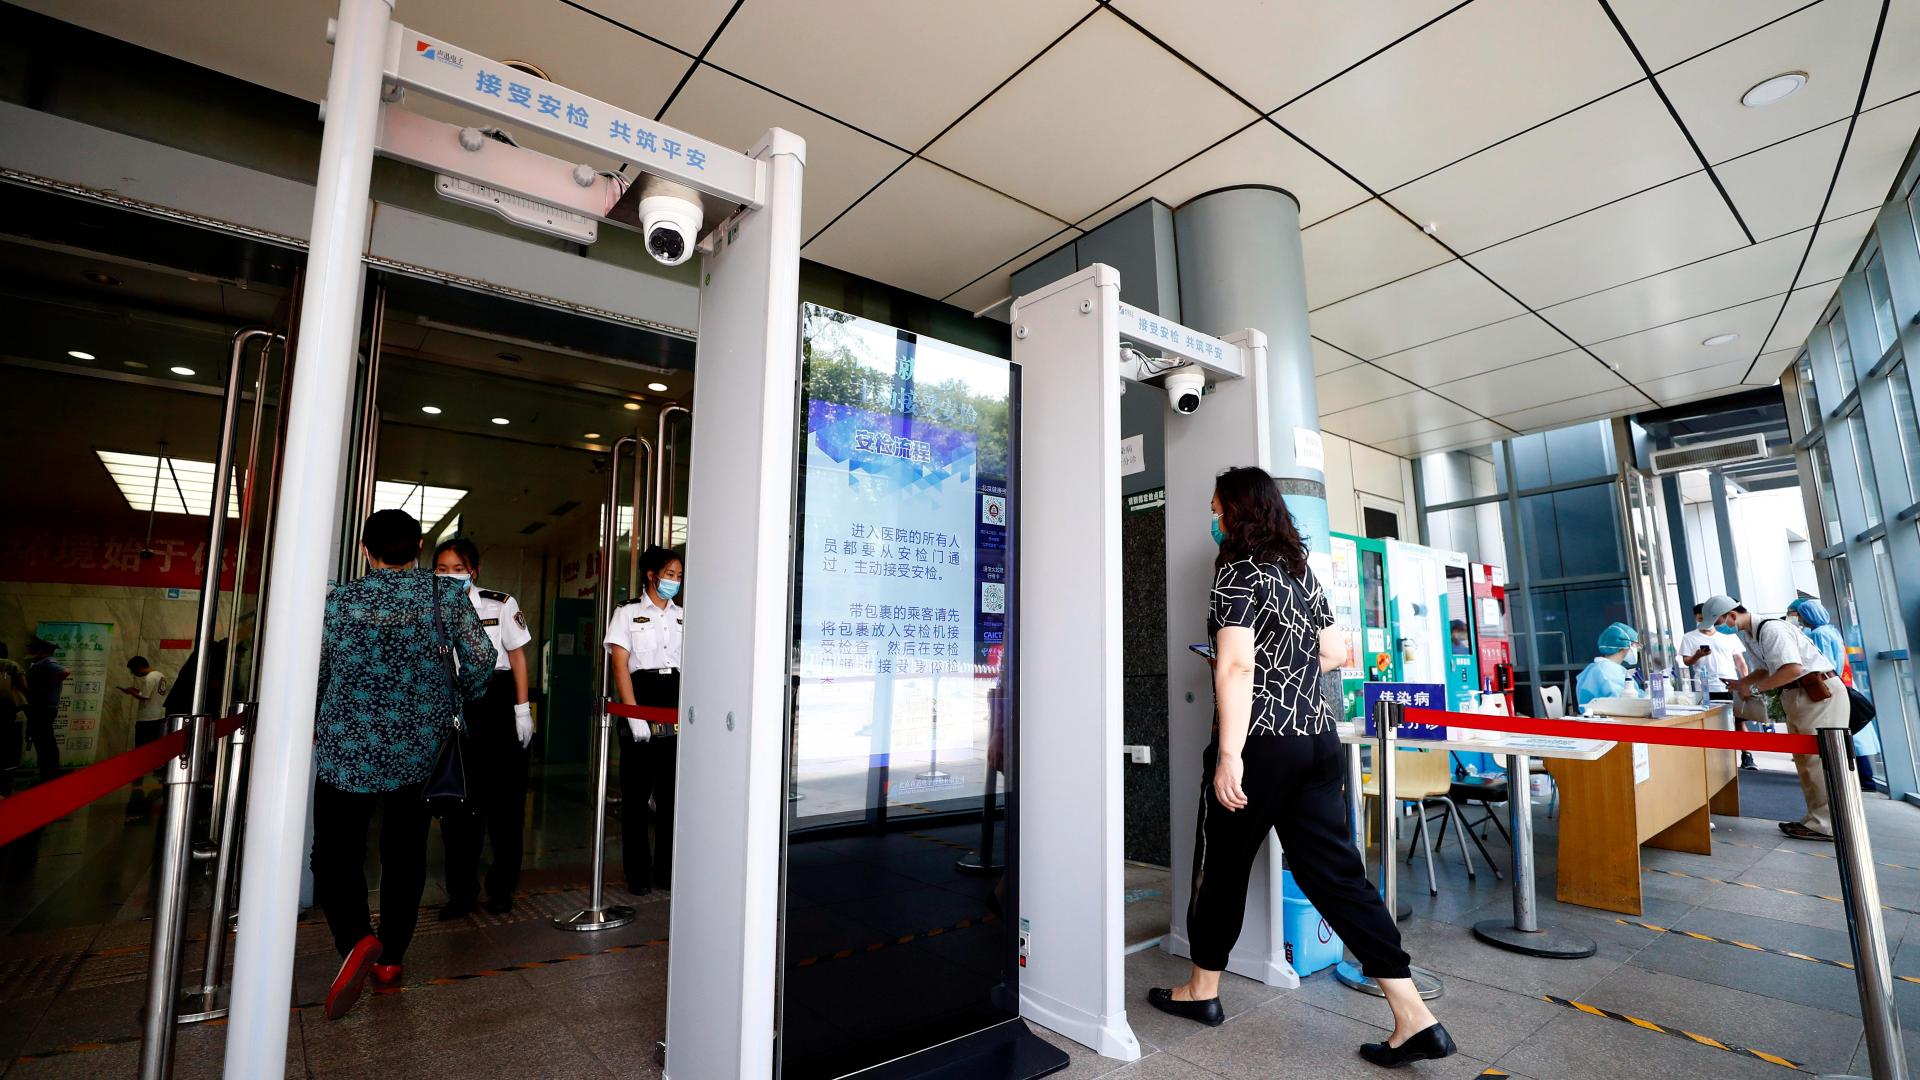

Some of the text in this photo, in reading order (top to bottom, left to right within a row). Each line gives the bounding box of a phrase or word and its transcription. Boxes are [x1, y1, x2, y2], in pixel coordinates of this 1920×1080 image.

[475, 69, 706, 170] 接受安检 共筑平安
[1138, 318, 1223, 360] 接受安检 共筑平安
[855, 429, 931, 463] 安检流程
[851, 523, 960, 549] 进入医院的所有人
[823, 538, 960, 566] 员都要从安检门通
[849, 603, 960, 622] 带包裹的乘客请先
[821, 620, 960, 639] 将包裹放入安检机接
[984, 631, 1003, 640] CAICT
[821, 640, 960, 656] 受检查，然后在安检
